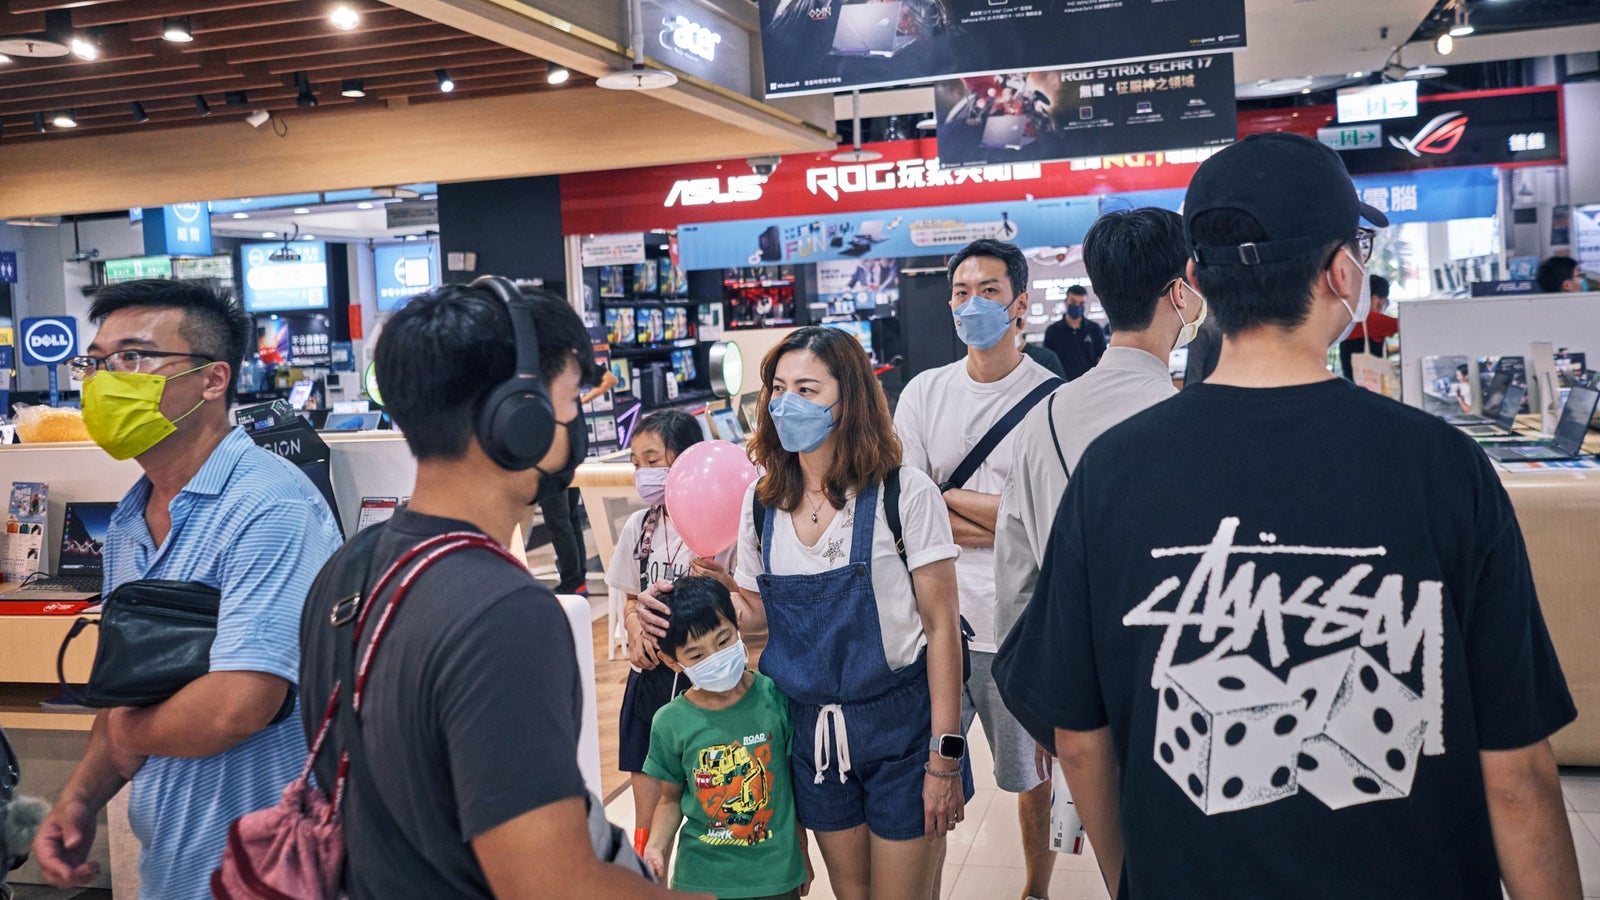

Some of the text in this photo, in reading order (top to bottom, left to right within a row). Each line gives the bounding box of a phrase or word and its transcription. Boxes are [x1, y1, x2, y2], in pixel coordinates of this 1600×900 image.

[1061, 57, 1213, 82] ROG STRIX SCAR 17
[664, 174, 763, 207] ASUS
[1496, 282, 1531, 292] ASUS
[31, 334, 68, 347] DELL
[743, 733, 764, 745] ROAD
